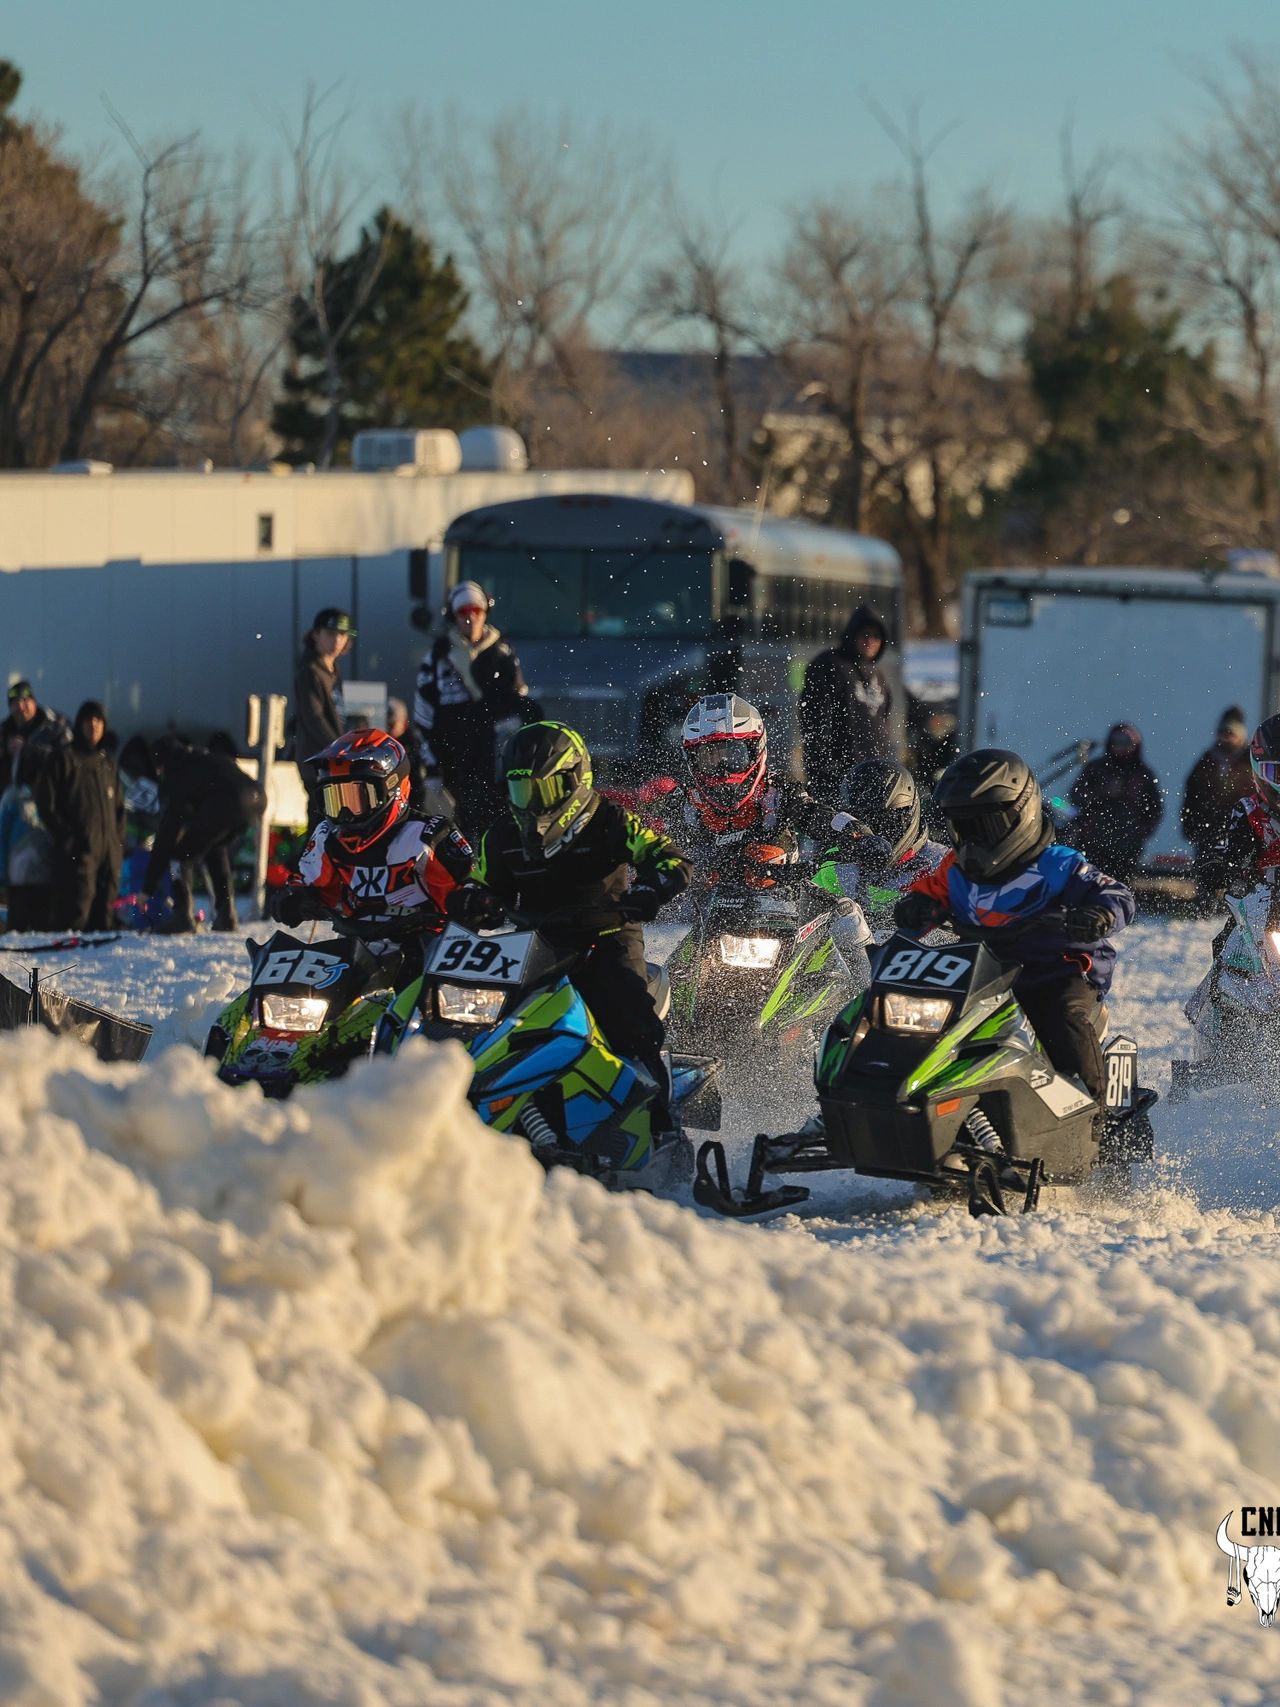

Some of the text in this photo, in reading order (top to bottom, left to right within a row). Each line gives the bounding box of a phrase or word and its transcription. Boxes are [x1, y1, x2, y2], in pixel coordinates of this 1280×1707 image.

[559, 799, 580, 828] FXR
[879, 949, 972, 987] 819
[1106, 1055, 1132, 1107] 819
